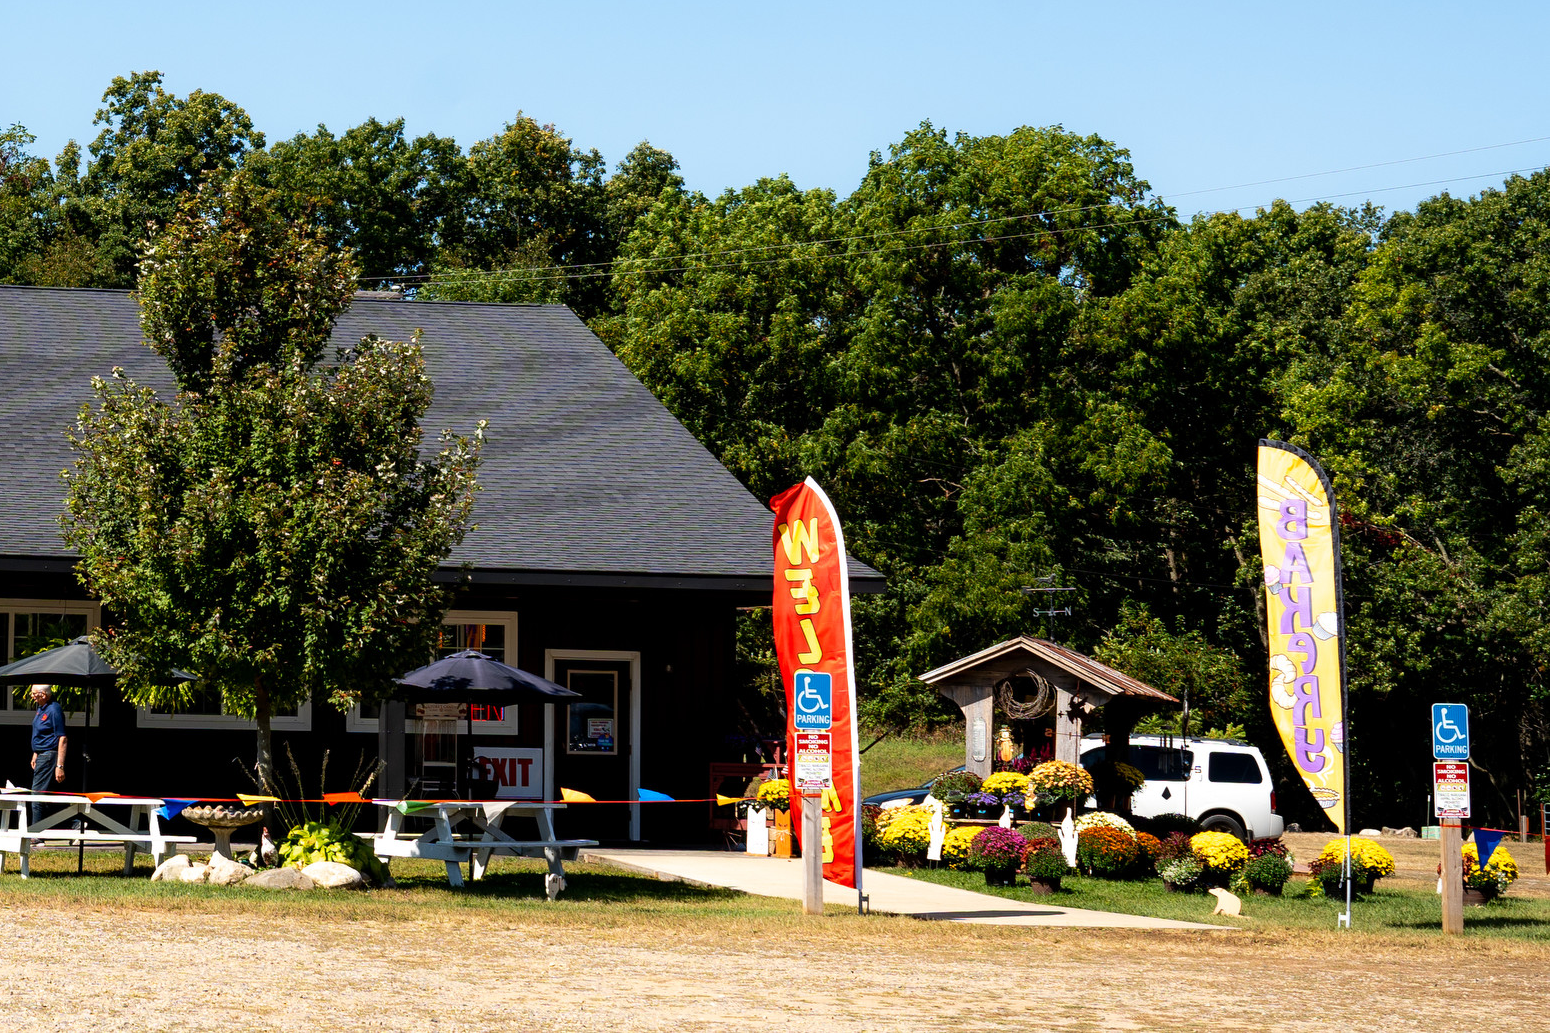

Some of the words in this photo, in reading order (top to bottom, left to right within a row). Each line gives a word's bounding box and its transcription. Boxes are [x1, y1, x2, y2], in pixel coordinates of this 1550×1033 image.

[796, 714, 830, 724] PARKING
[1436, 744, 1468, 754] PARKING
[479, 757, 533, 787] EXIT
